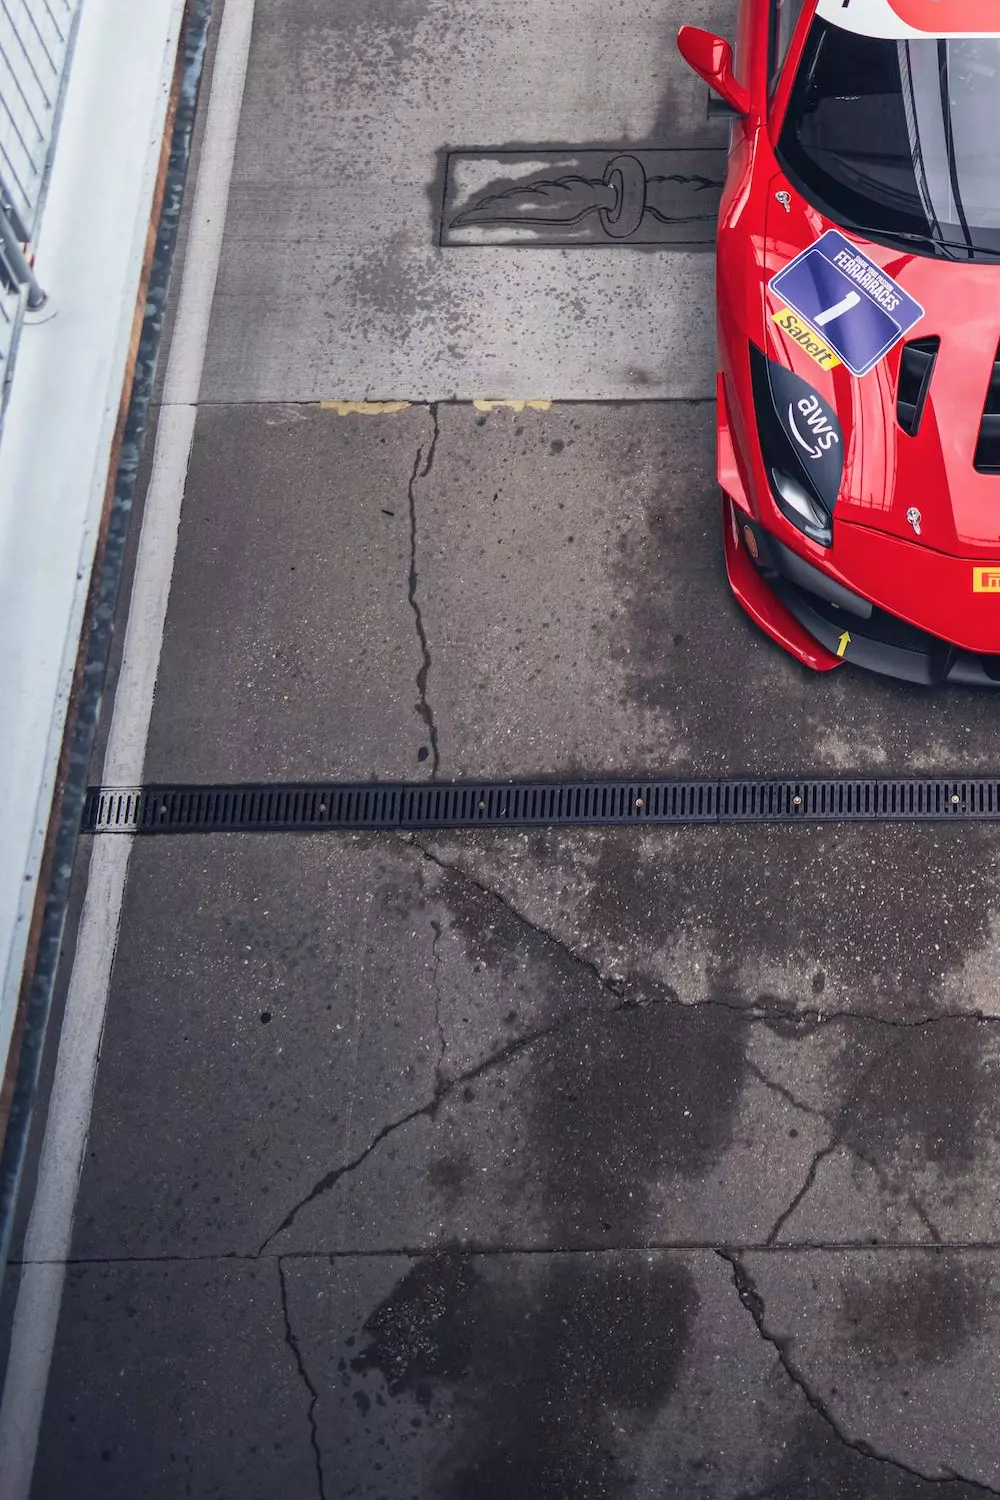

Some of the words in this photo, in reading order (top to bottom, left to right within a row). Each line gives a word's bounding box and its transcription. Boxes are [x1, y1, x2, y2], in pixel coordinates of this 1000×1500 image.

[832, 250, 900, 312] FERRARIRACES
[813, 290, 861, 327] 1
[779, 314, 833, 365] Sabelt
[798, 395, 839, 450] aws
